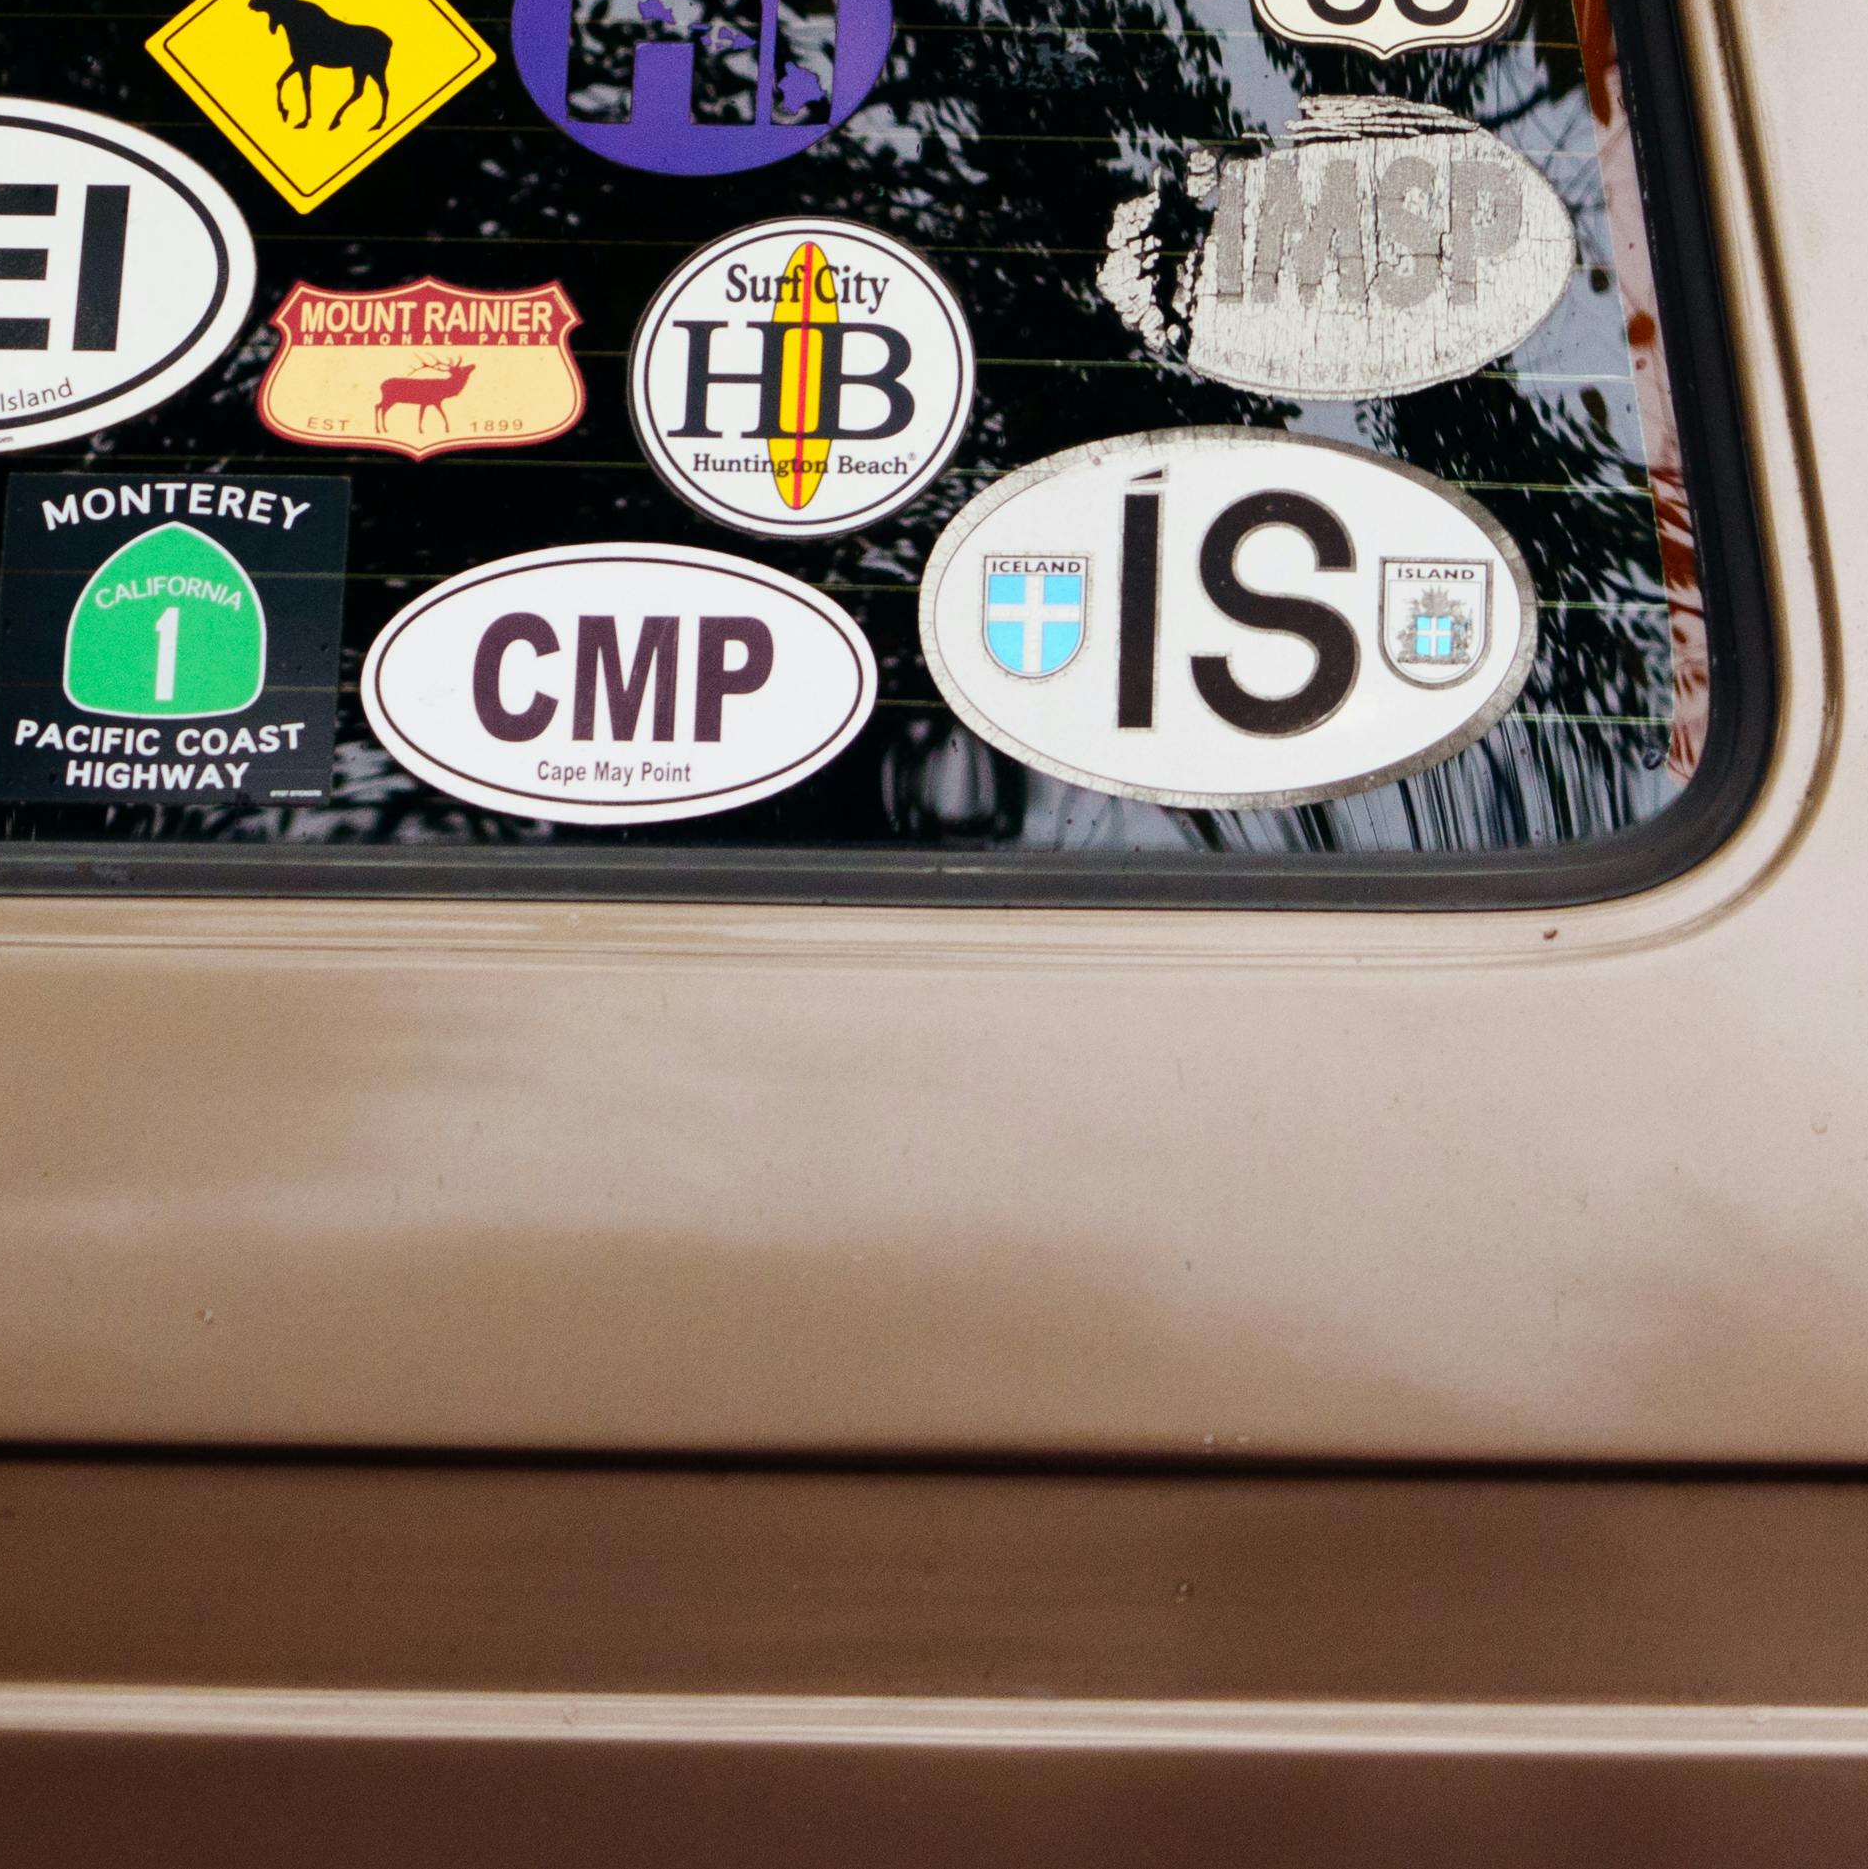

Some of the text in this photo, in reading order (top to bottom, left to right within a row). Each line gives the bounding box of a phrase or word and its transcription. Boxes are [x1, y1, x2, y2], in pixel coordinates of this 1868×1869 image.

[725, 263, 891, 315] Surf City
[300, 301, 418, 332] MOUNT
[424, 301, 553, 332] RAINIER
[303, 333, 550, 347] NATIONAL PARK
[0, 376, 74, 412] Island
[667, 320, 915, 440] HB
[306, 416, 524, 433] EST 1899
[692, 453, 908, 478] Huntington Beach
[41, 482, 311, 531] MONTEREY
[990, 560, 1082, 574] ICELAND
[94, 575, 243, 612] CALIFORNIA
[154, 606, 180, 701] 1
[472, 611, 775, 743] CMP
[14, 719, 306, 757] PACIFIC COAST
[65, 759, 251, 791] HIGHWAY
[536, 760, 692, 787] Cape May Point
